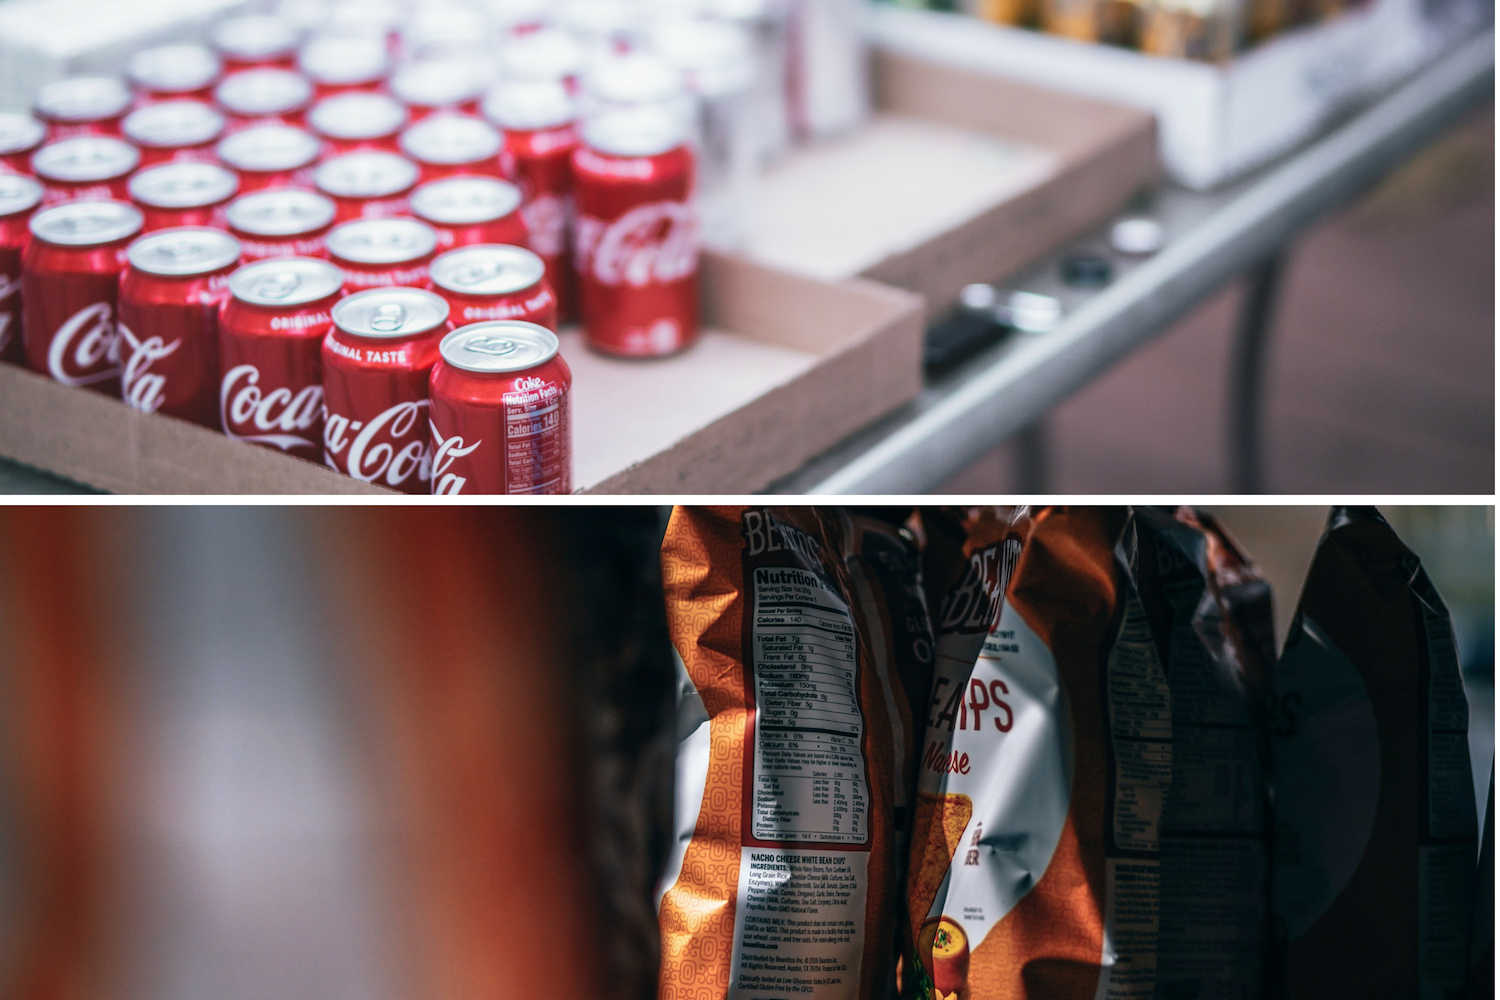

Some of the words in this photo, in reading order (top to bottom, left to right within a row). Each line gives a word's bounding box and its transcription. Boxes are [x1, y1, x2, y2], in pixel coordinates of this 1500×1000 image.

[366, 351, 407, 363] TASTE
[506, 391, 539, 406] Nutrition
[540, 386, 557, 398] Facts
[507, 422, 542, 435] Calories
[543, 411, 559, 427] 140
[756, 570, 818, 588] Nutrition
[758, 586, 780, 594] Serving
[801, 664, 813, 672] 0mg
[778, 691, 818, 699] Carbohydrate
[765, 700, 786, 708] Dietary
[765, 709, 786, 717] Sugars
[751, 853, 774, 862] NACHO
[776, 854, 801, 864] CHEESE
[802, 855, 818, 864] WHITE
[819, 856, 832, 865] BEAN
[750, 863, 789, 871] INGREDIENTS:
[749, 871, 761, 879] Long
[745, 916, 771, 924] CONTAINS
[743, 941, 778, 950] beanitos.com
